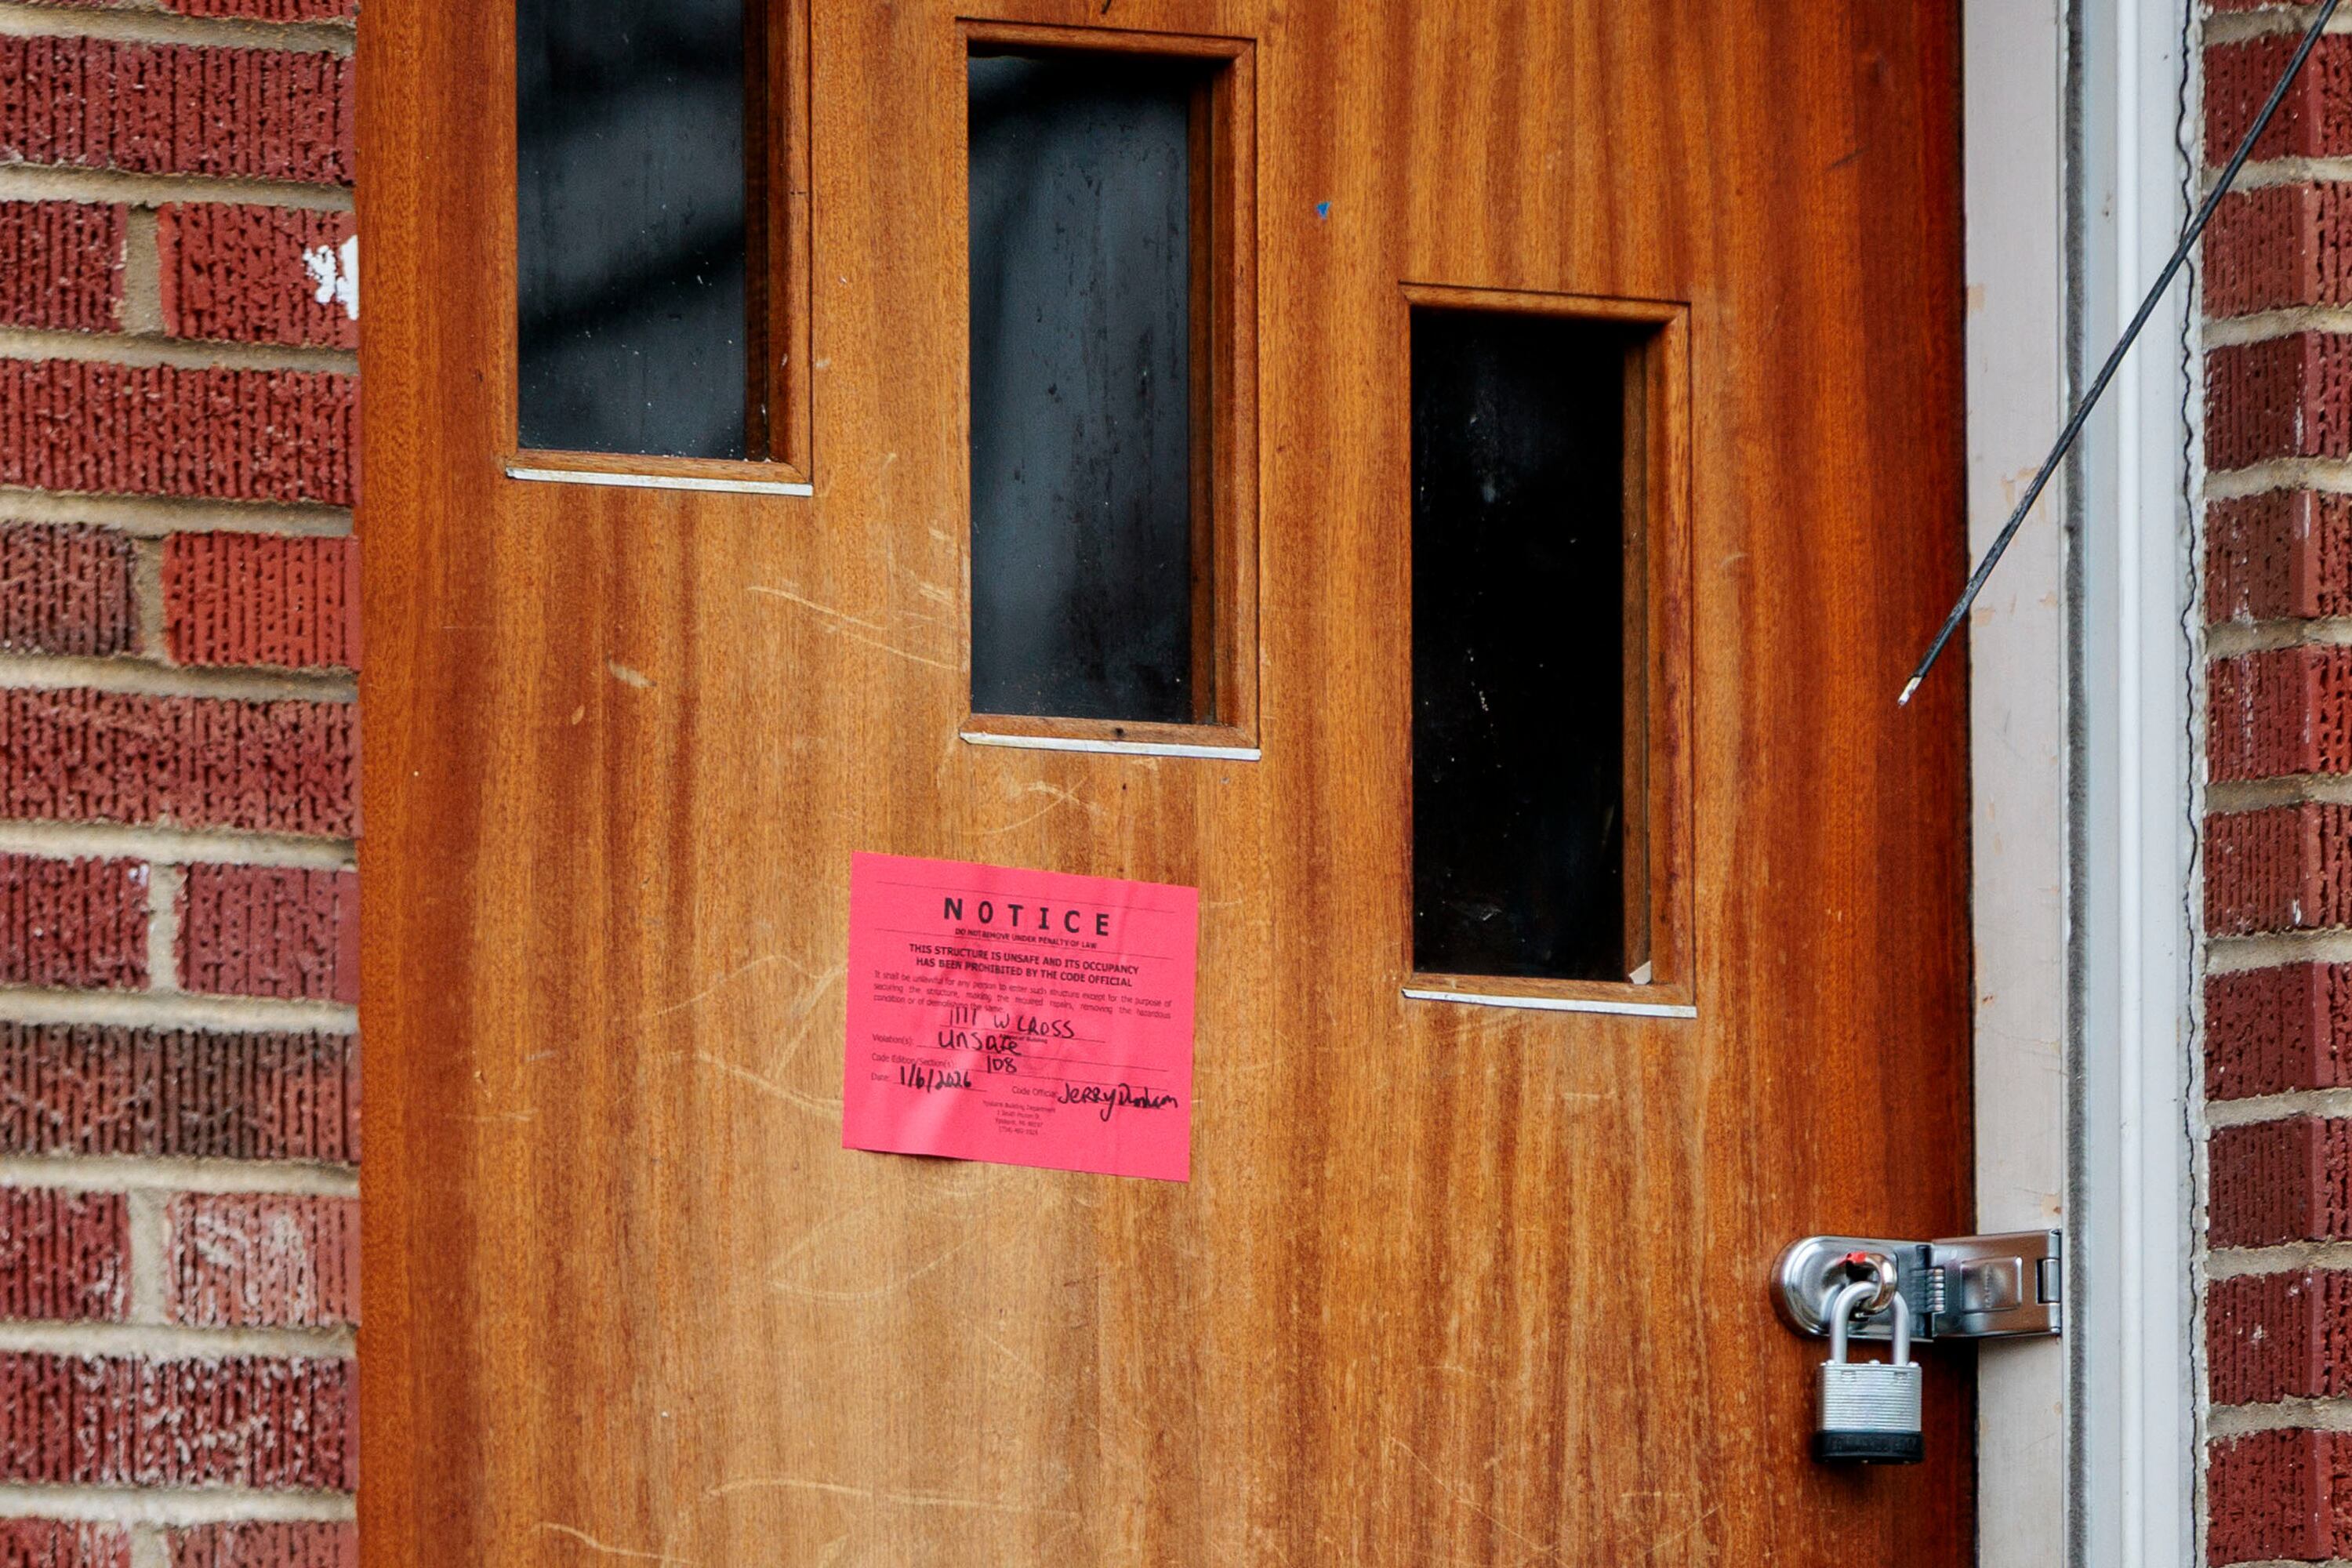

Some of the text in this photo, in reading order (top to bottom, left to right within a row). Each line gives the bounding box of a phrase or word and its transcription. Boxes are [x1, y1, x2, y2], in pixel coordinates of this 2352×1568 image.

[943, 897, 1109, 936] NOTICE
[1012, 934, 1036, 943] UNDER
[1038, 936, 1069, 946] PENALTY
[909, 943, 1139, 975] THIS STRUCTURE IS UNSAFE AND ITS OCCUPANCY
[916, 956, 1133, 987] HAS BEEN PROHIBITED BY THE CODE OFFICIAL
[873, 994, 906, 1004] condition
[873, 983, 904, 994] securing
[909, 985, 920, 994] the
[997, 994, 1009, 1003] the
[1080, 1003, 1112, 1014] removing
[1119, 1006, 1132, 1014] the
[1136, 1008, 1171, 1019] hazardous
[883, 971, 899, 980] shall
[902, 973, 910, 982] be
[945, 976, 954, 985] for
[957, 979, 970, 989] any
[973, 982, 996, 992] person
[1009, 985, 1028, 993] enter
[1029, 985, 1047, 995] such
[1049, 988, 1080, 999] structure
[1108, 993, 1117, 1003] for
[1121, 995, 1133, 1004] the
[1135, 998, 1162, 1008] purpose
[1164, 1000, 1172, 1008] of
[1017, 1015, 1075, 1039] CROSS
[872, 1052, 890, 1062] Code
[987, 1055, 1017, 1073] 108
[1011, 1086, 1031, 1095] Code
